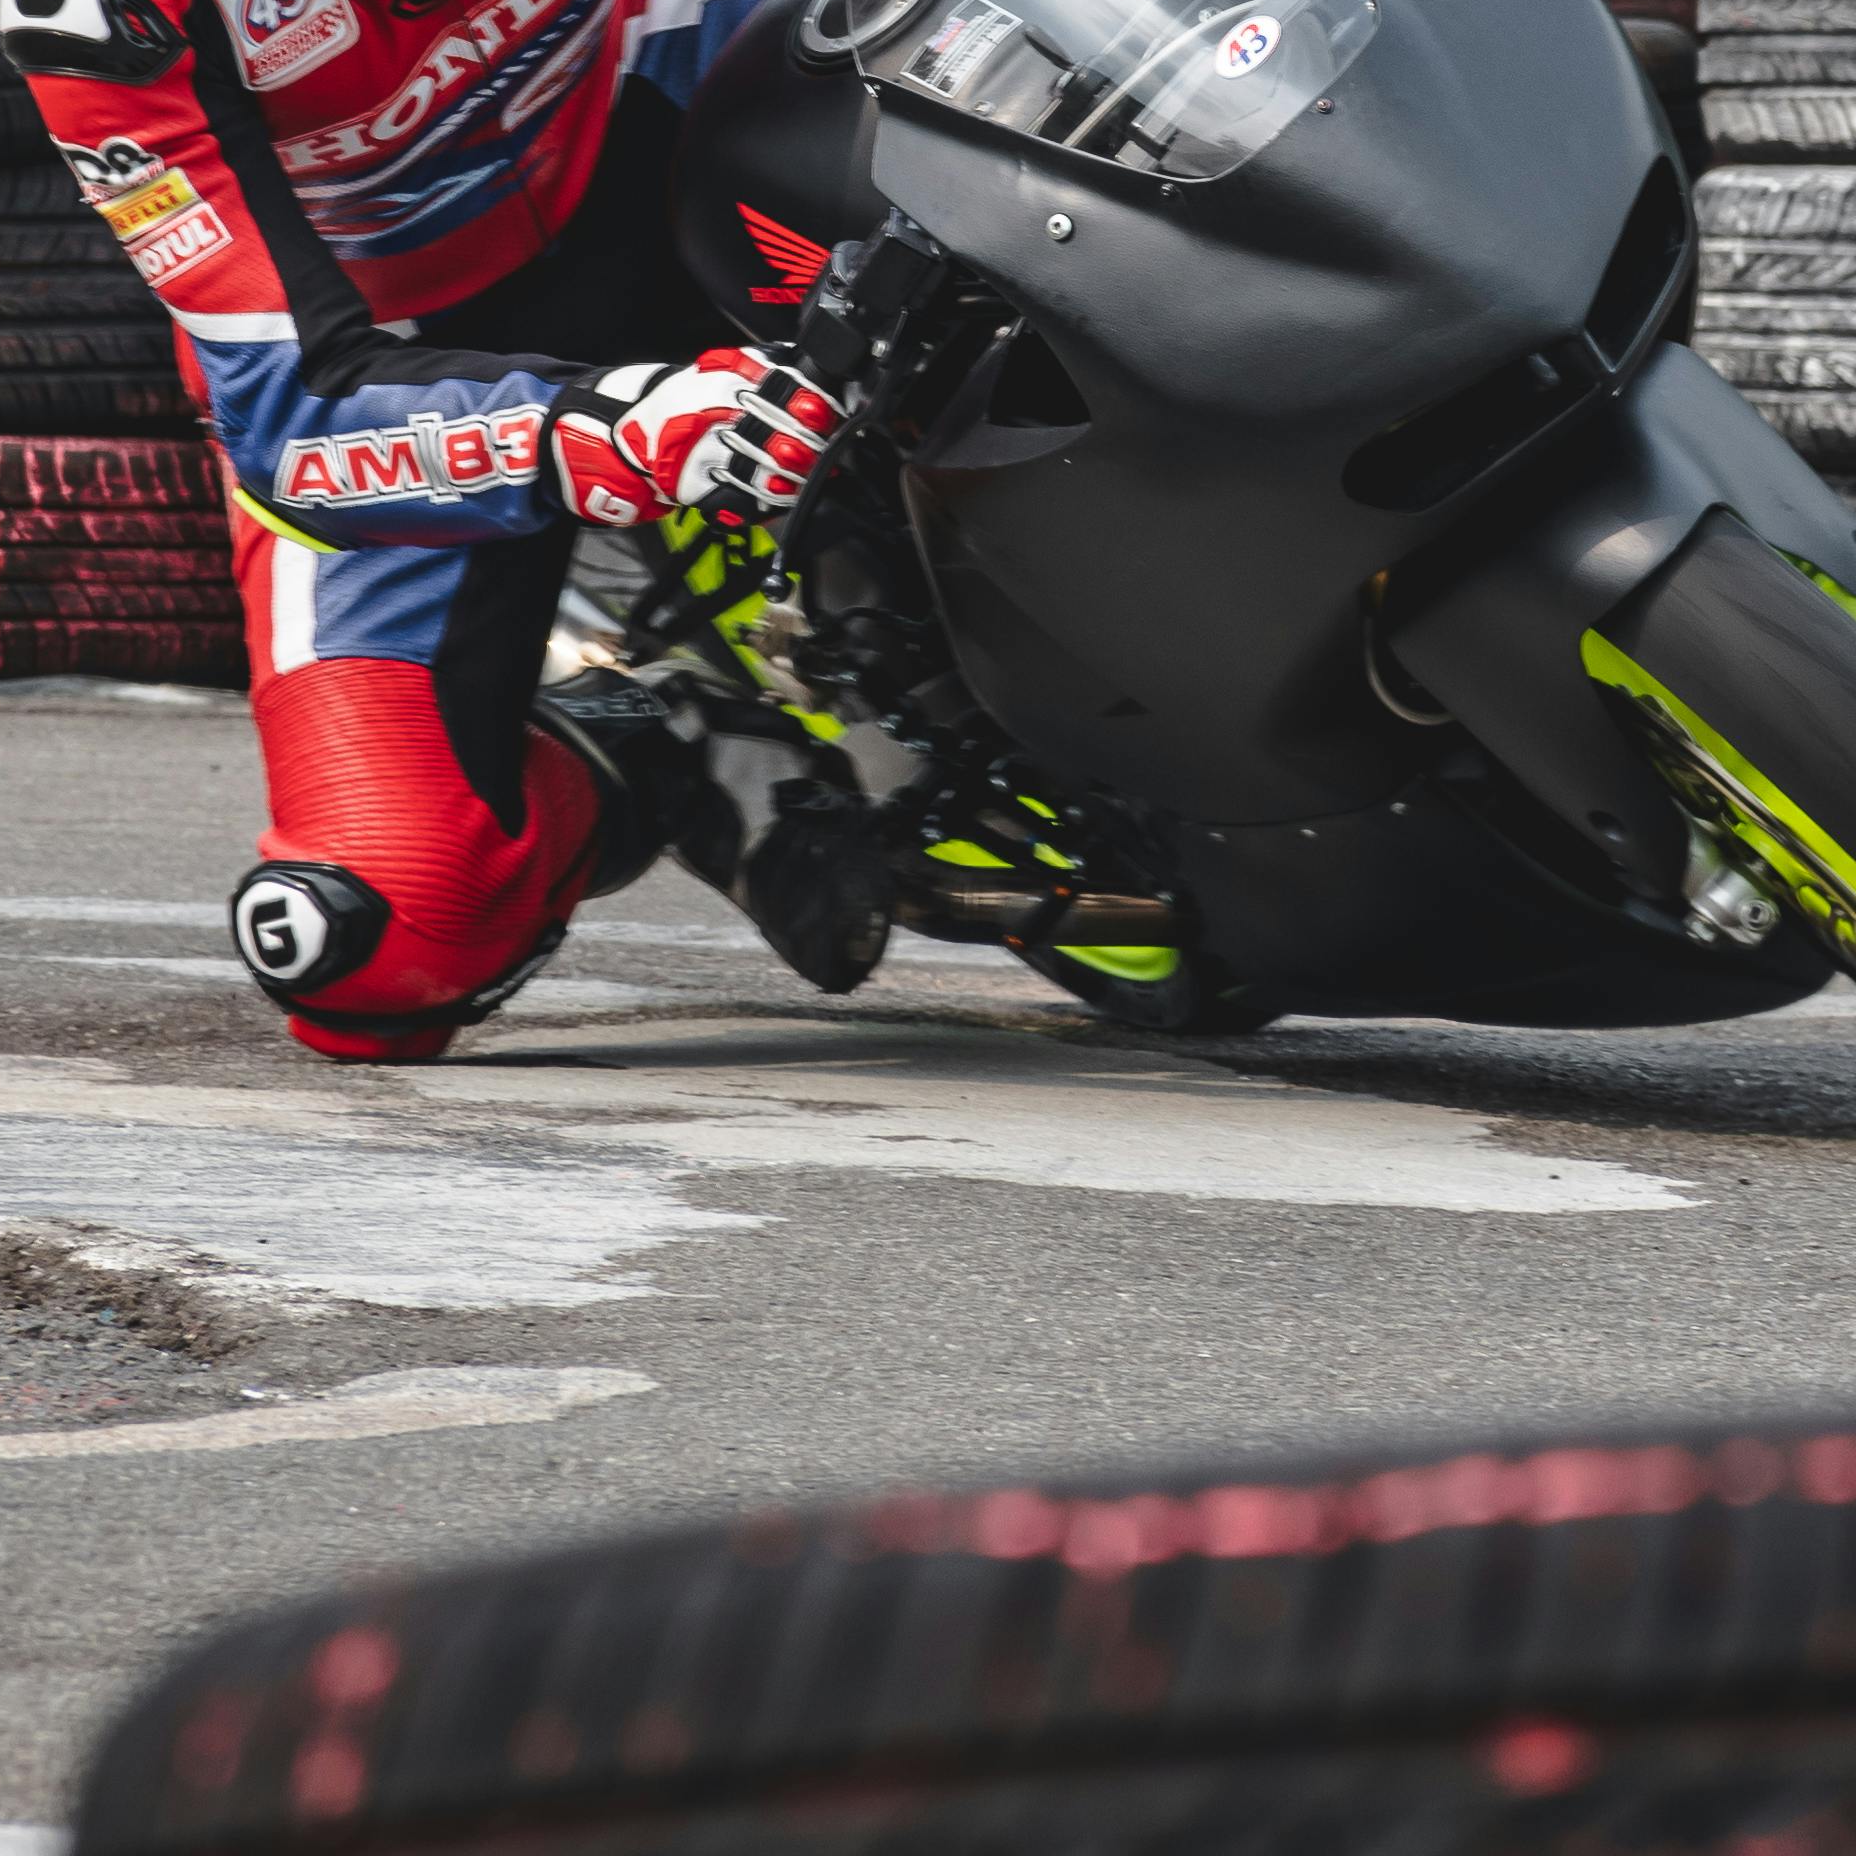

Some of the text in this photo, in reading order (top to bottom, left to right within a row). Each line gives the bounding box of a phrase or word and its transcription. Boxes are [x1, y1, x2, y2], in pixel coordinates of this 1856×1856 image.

[1229, 24, 1268, 66] 43
[109, 184, 180, 232] RELLI
[137, 216, 218, 276] OTUL
[286, 416, 541, 499] AM 83
